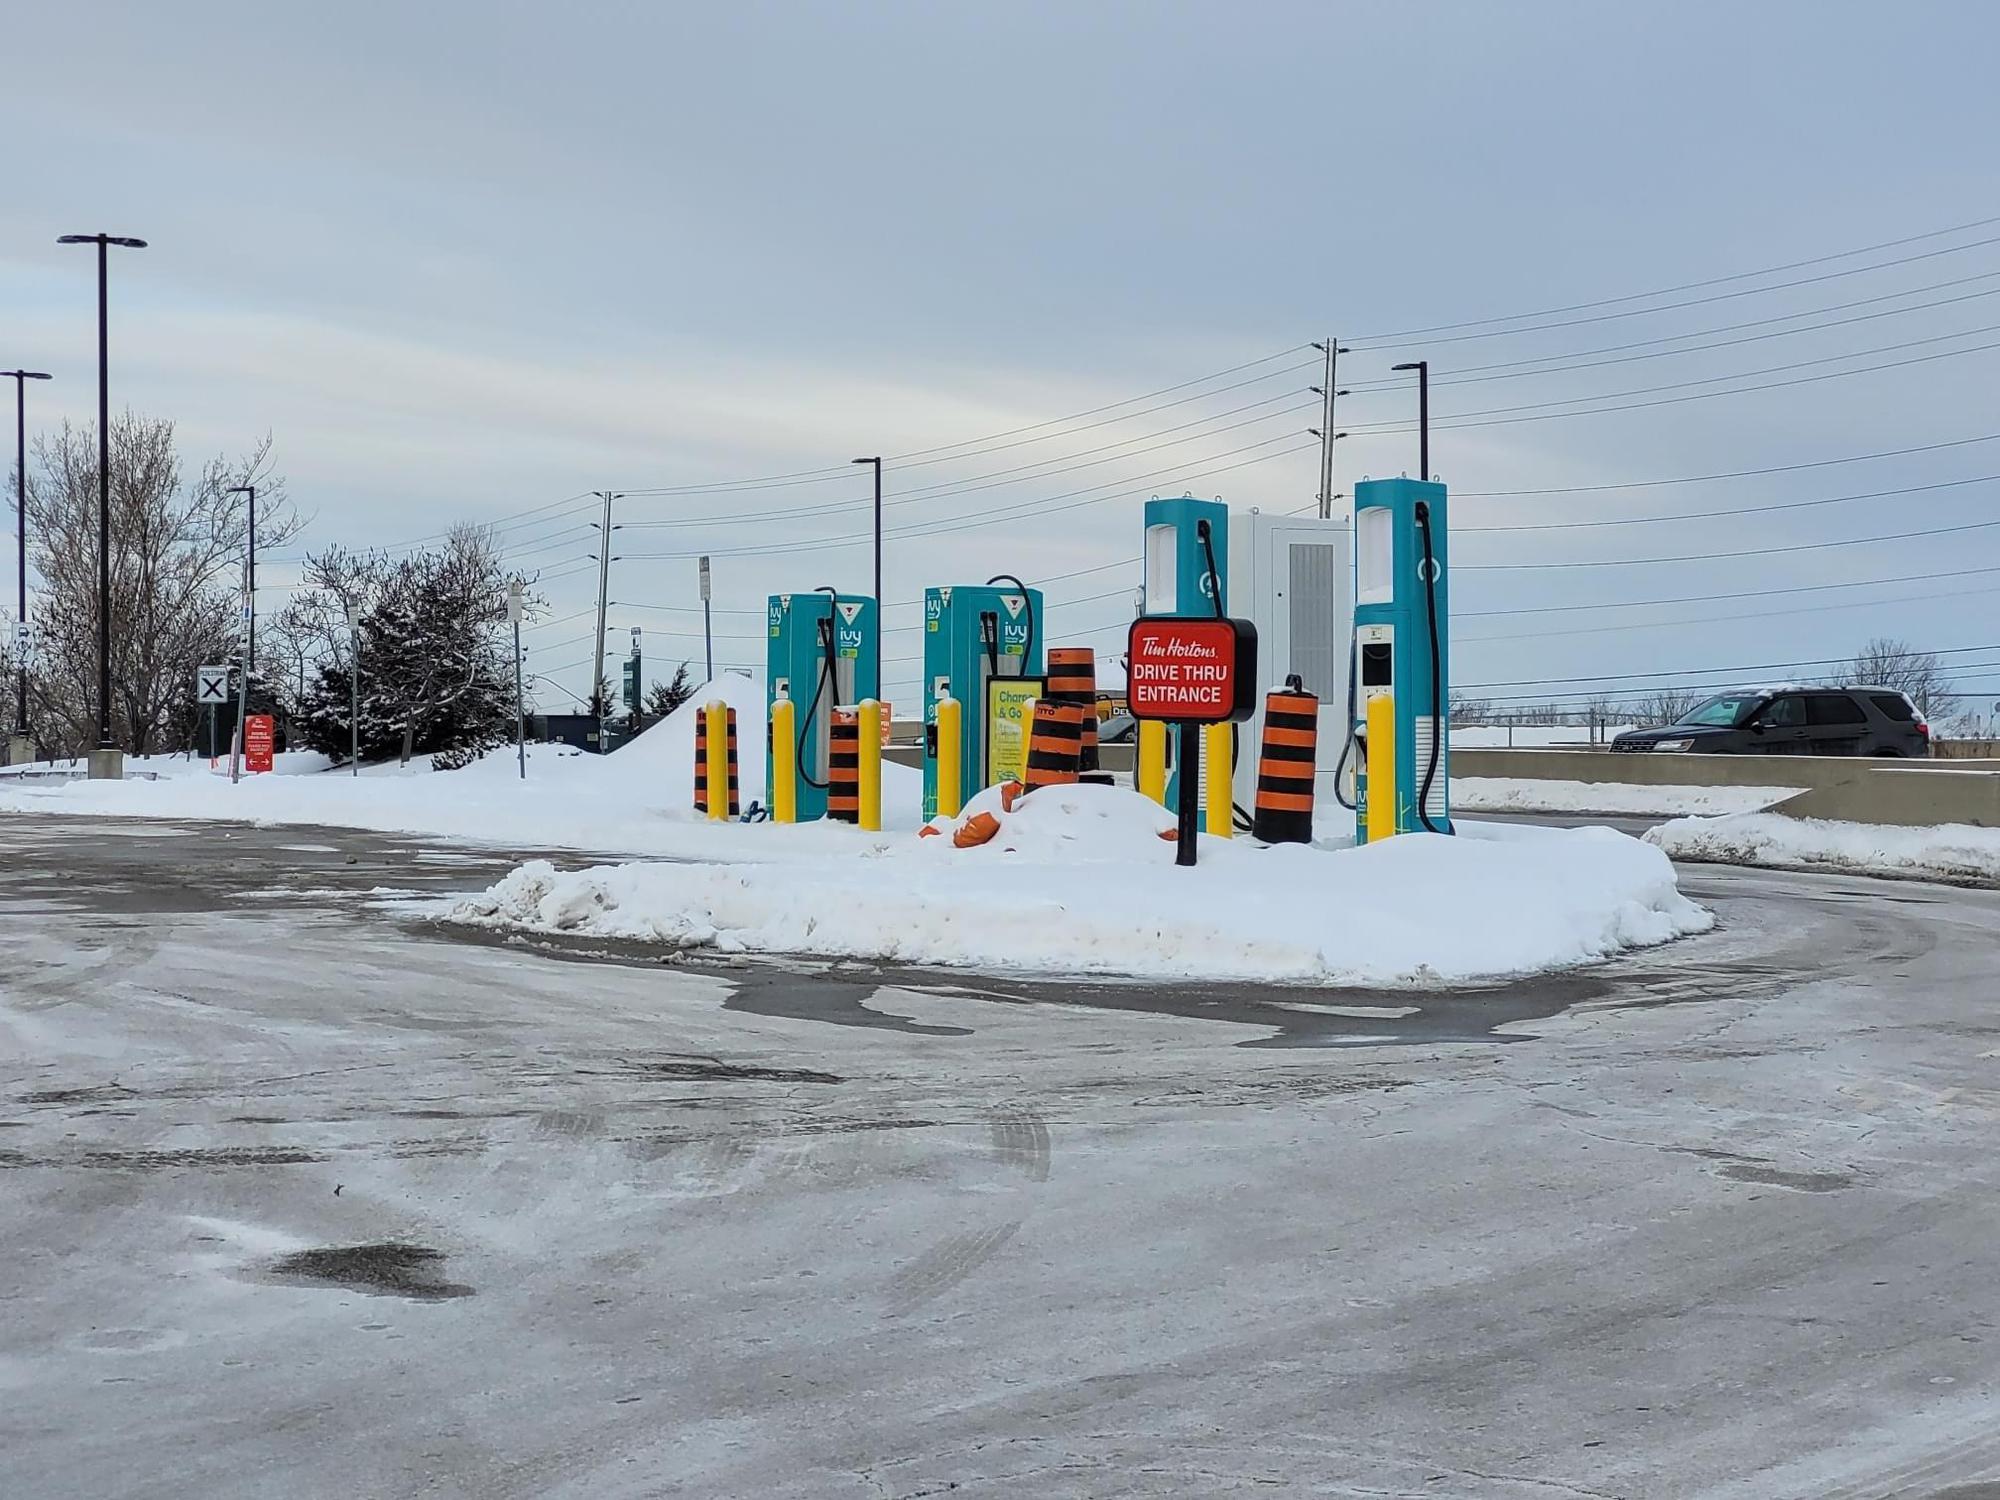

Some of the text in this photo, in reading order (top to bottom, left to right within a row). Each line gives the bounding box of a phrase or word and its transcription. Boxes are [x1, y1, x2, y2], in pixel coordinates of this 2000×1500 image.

[840, 627, 861, 647] ivy
[1005, 621, 1027, 643] ivy
[1142, 637, 1216, 657] Tim Hortons
[1134, 664, 1227, 680] DRIVE THRU
[1138, 686, 1221, 702] ENTRANCE
[1008, 706, 1022, 719] Go
